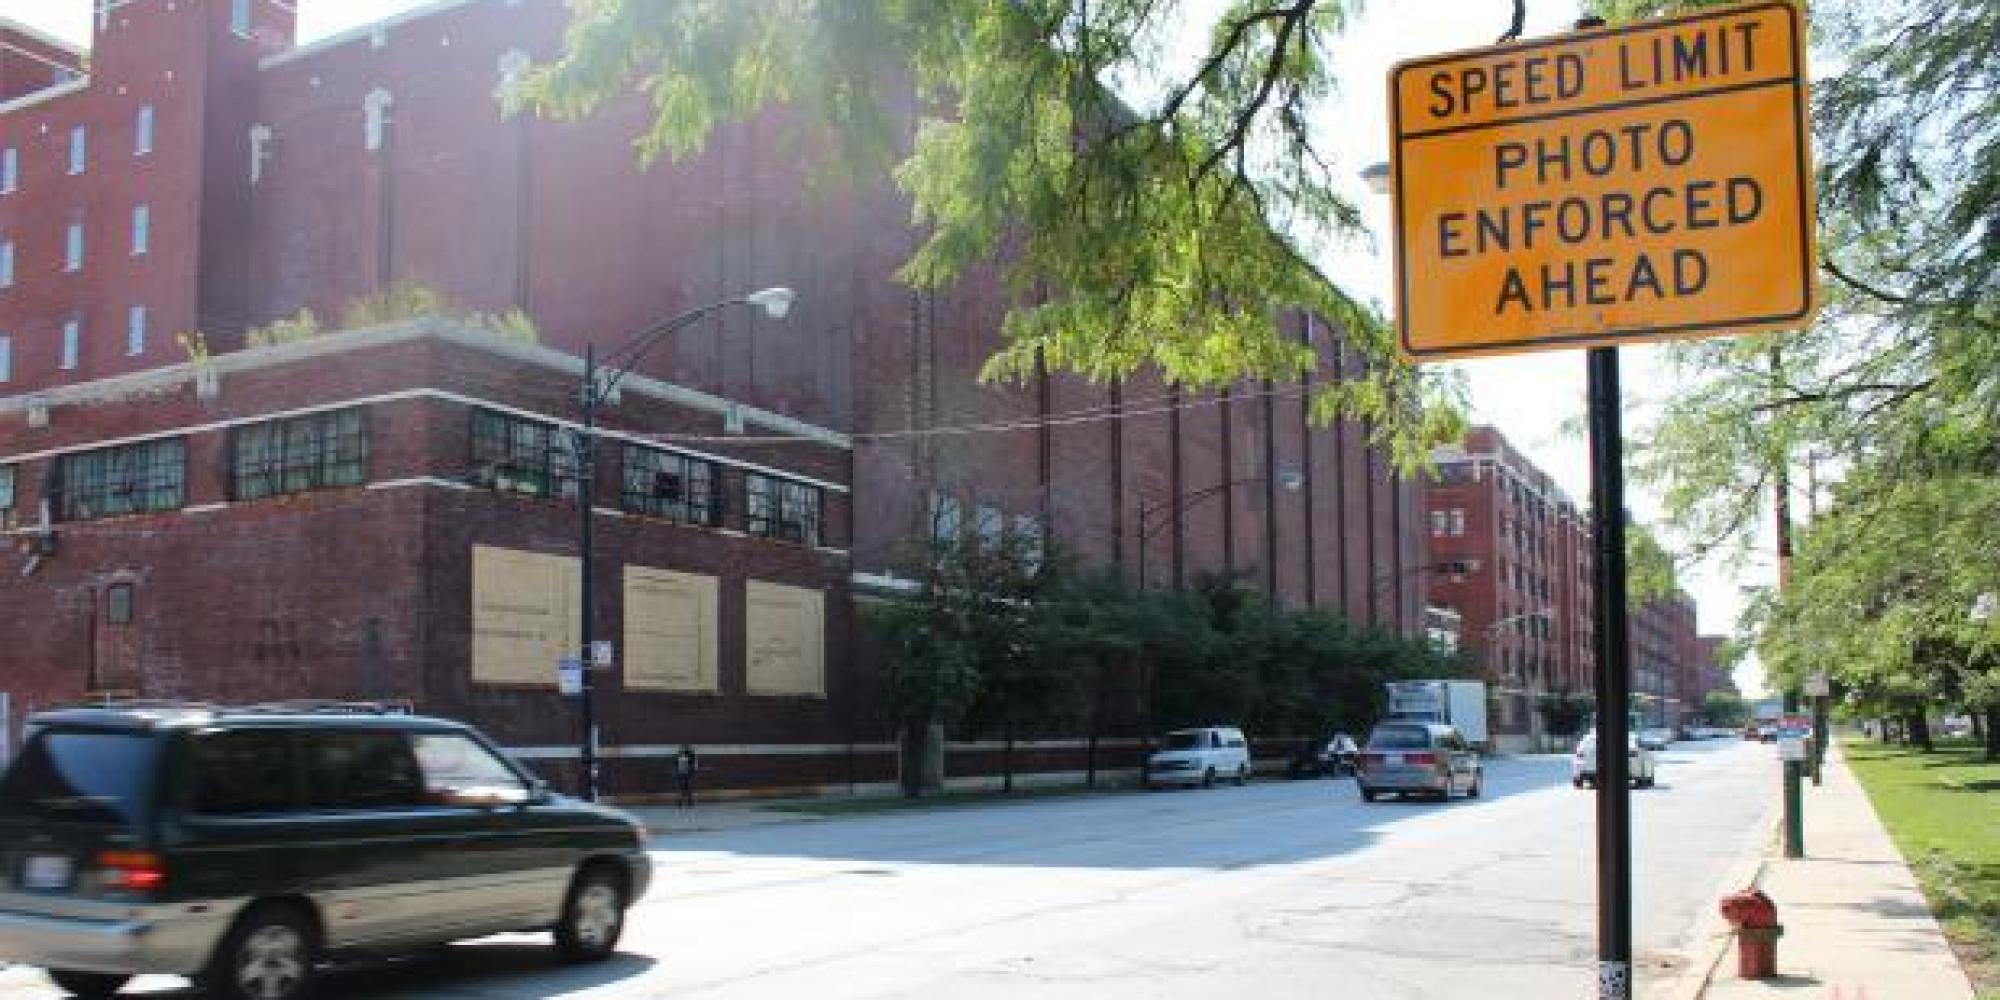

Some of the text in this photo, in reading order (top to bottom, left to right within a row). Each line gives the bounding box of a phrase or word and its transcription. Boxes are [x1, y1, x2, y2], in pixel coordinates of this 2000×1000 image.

[1429, 22, 1760, 118] SPEED LIMIT
[1496, 119, 1693, 188] PHOTO
[1438, 177, 1763, 259] ENFORCED
[1495, 248, 1709, 314] AHEAD
